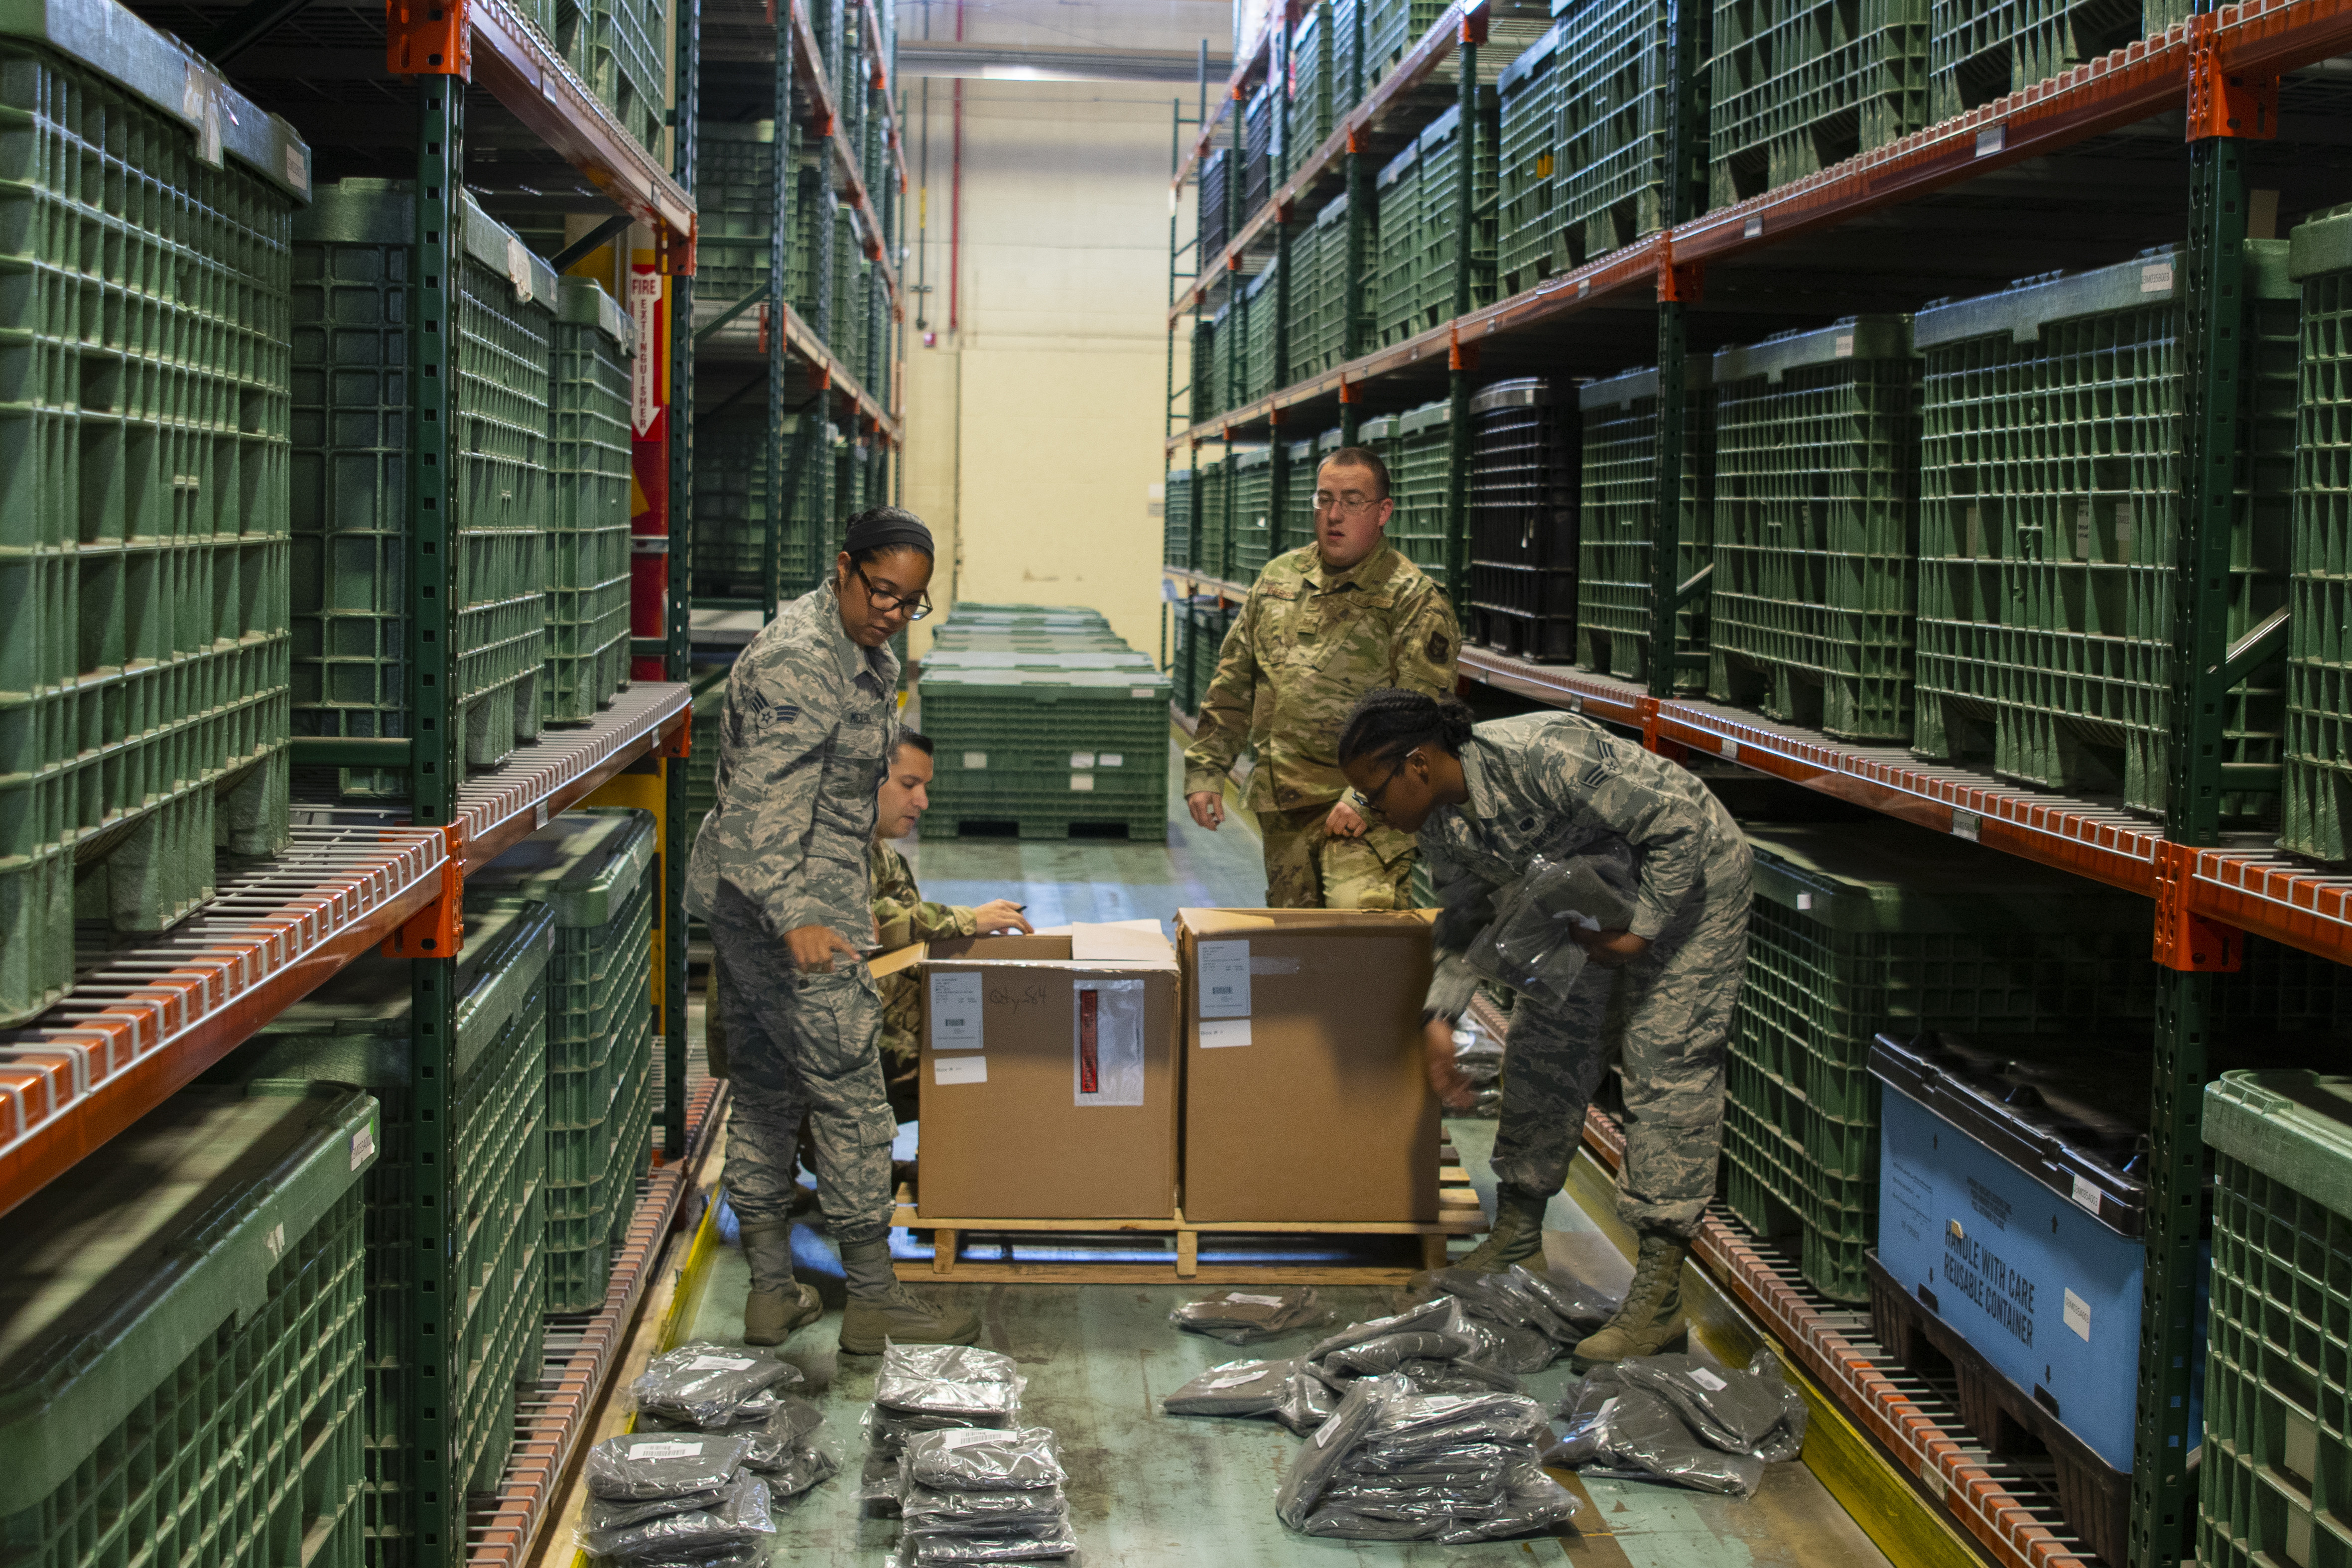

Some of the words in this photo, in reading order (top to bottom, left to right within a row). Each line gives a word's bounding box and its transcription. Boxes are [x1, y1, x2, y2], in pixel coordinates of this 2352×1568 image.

[632, 279, 656, 295] FIRE
[1944, 1252, 1983, 1307] REUSABLE
[1985, 1286, 2033, 1349] CONTAINER
[1945, 1219, 1979, 1270] HANDLE
[1982, 1247, 2005, 1291] WITH
[2009, 1269, 2035, 1314] CARE
